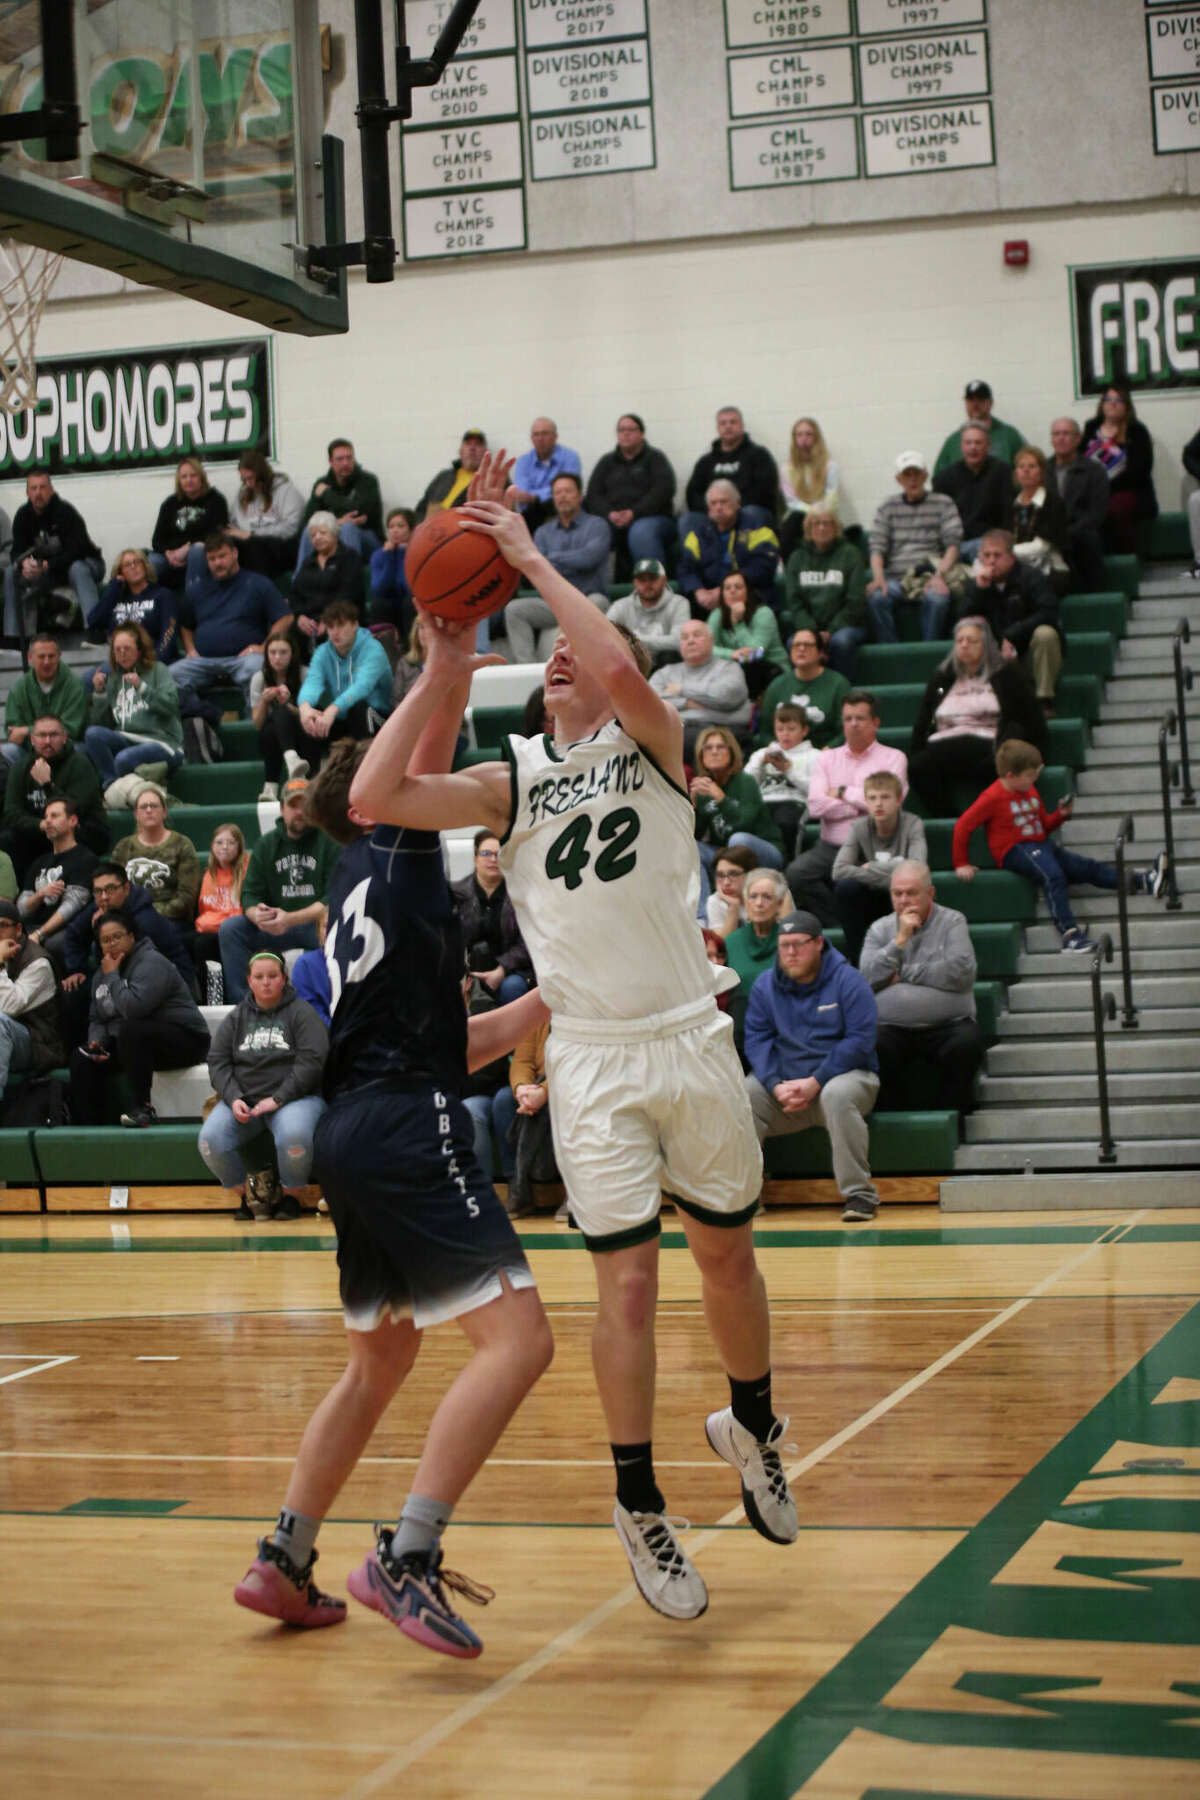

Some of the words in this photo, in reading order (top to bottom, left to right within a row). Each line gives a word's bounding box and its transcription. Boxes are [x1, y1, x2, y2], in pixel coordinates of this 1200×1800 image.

[556, 3, 615, 21] CHAMPS
[752, 5, 822, 24] CHAMPS
[903, 7, 939, 24] 1997
[567, 20, 606, 36] 2017
[769, 22, 809, 38] 1980
[1157, 16, 1200, 37] DIVI
[532, 47, 642, 75] DIVISIONAL
[867, 39, 977, 65] DIVISIONAL
[441, 66, 478, 84] TVC
[769, 57, 811, 75] CML
[891, 61, 954, 79] CHAMPS
[559, 70, 618, 88] CHAMPS
[756, 75, 826, 94] CHAMPS
[908, 80, 943, 95] 1997
[430, 84, 488, 102] CHAMPS
[570, 86, 609, 102] 2018
[775, 92, 809, 107] 1981
[441, 102, 478, 117] 2010
[536, 114, 646, 142] DIVISIONAL
[871, 109, 982, 136] DIVISIONAL
[441, 131, 482, 150] TVC
[562, 136, 622, 155] CHAMPS
[770, 129, 813, 147] CML
[896, 132, 960, 150] CHAMPS
[432, 150, 492, 167] CHAMPS
[573, 153, 609, 169] 2021
[759, 148, 826, 167] CHAMPS
[910, 151, 947, 167] 1998
[444, 168, 482, 183] 2011
[774, 164, 815, 179] 1987
[442, 198, 484, 217] TVC
[434, 216, 494, 234] CHAMPS
[445, 234, 485, 249] 2012
[0, 356, 256, 466] OPHOMORES
[545, 806, 641, 891] 42
